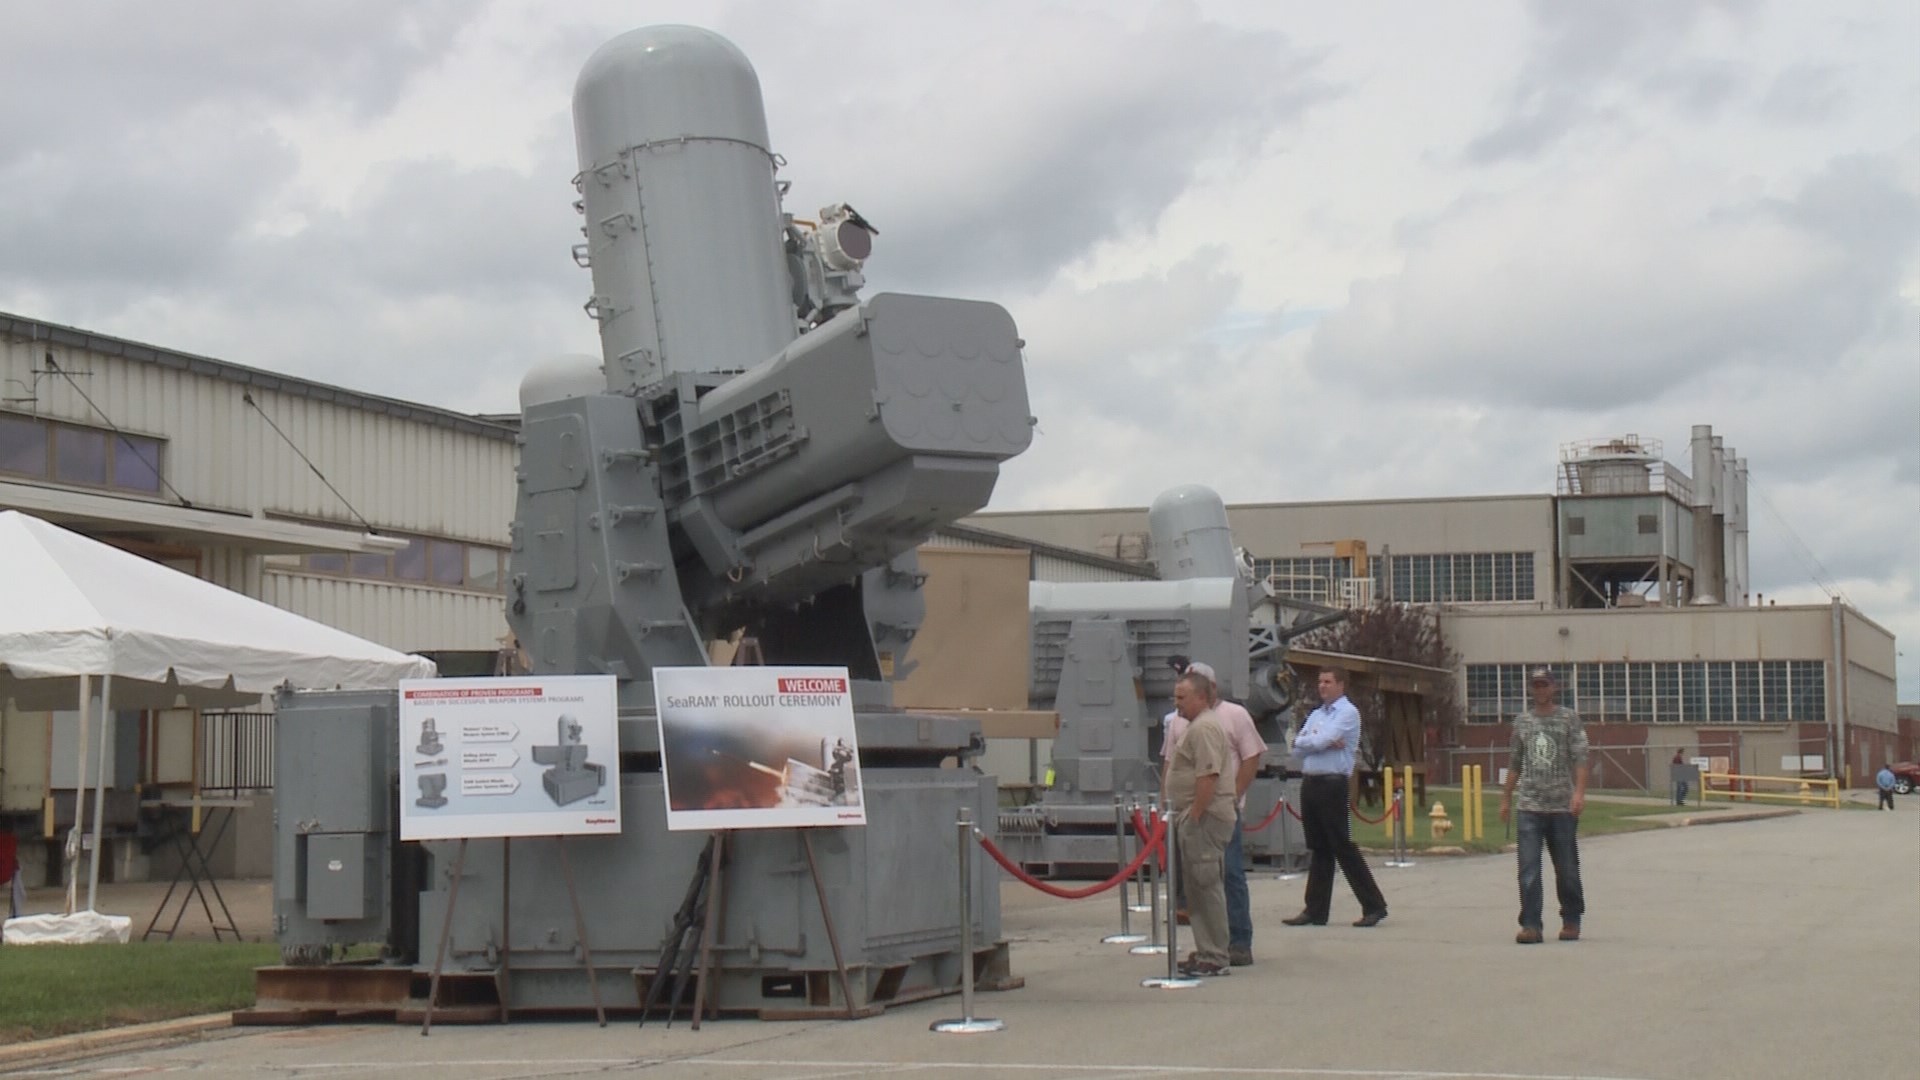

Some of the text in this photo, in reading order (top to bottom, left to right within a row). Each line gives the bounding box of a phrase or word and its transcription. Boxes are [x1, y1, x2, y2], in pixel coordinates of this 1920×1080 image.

[785, 679, 841, 692] WELCOME
[724, 695, 775, 707] ROLLOUT
[779, 694, 842, 707] CEREMONY
